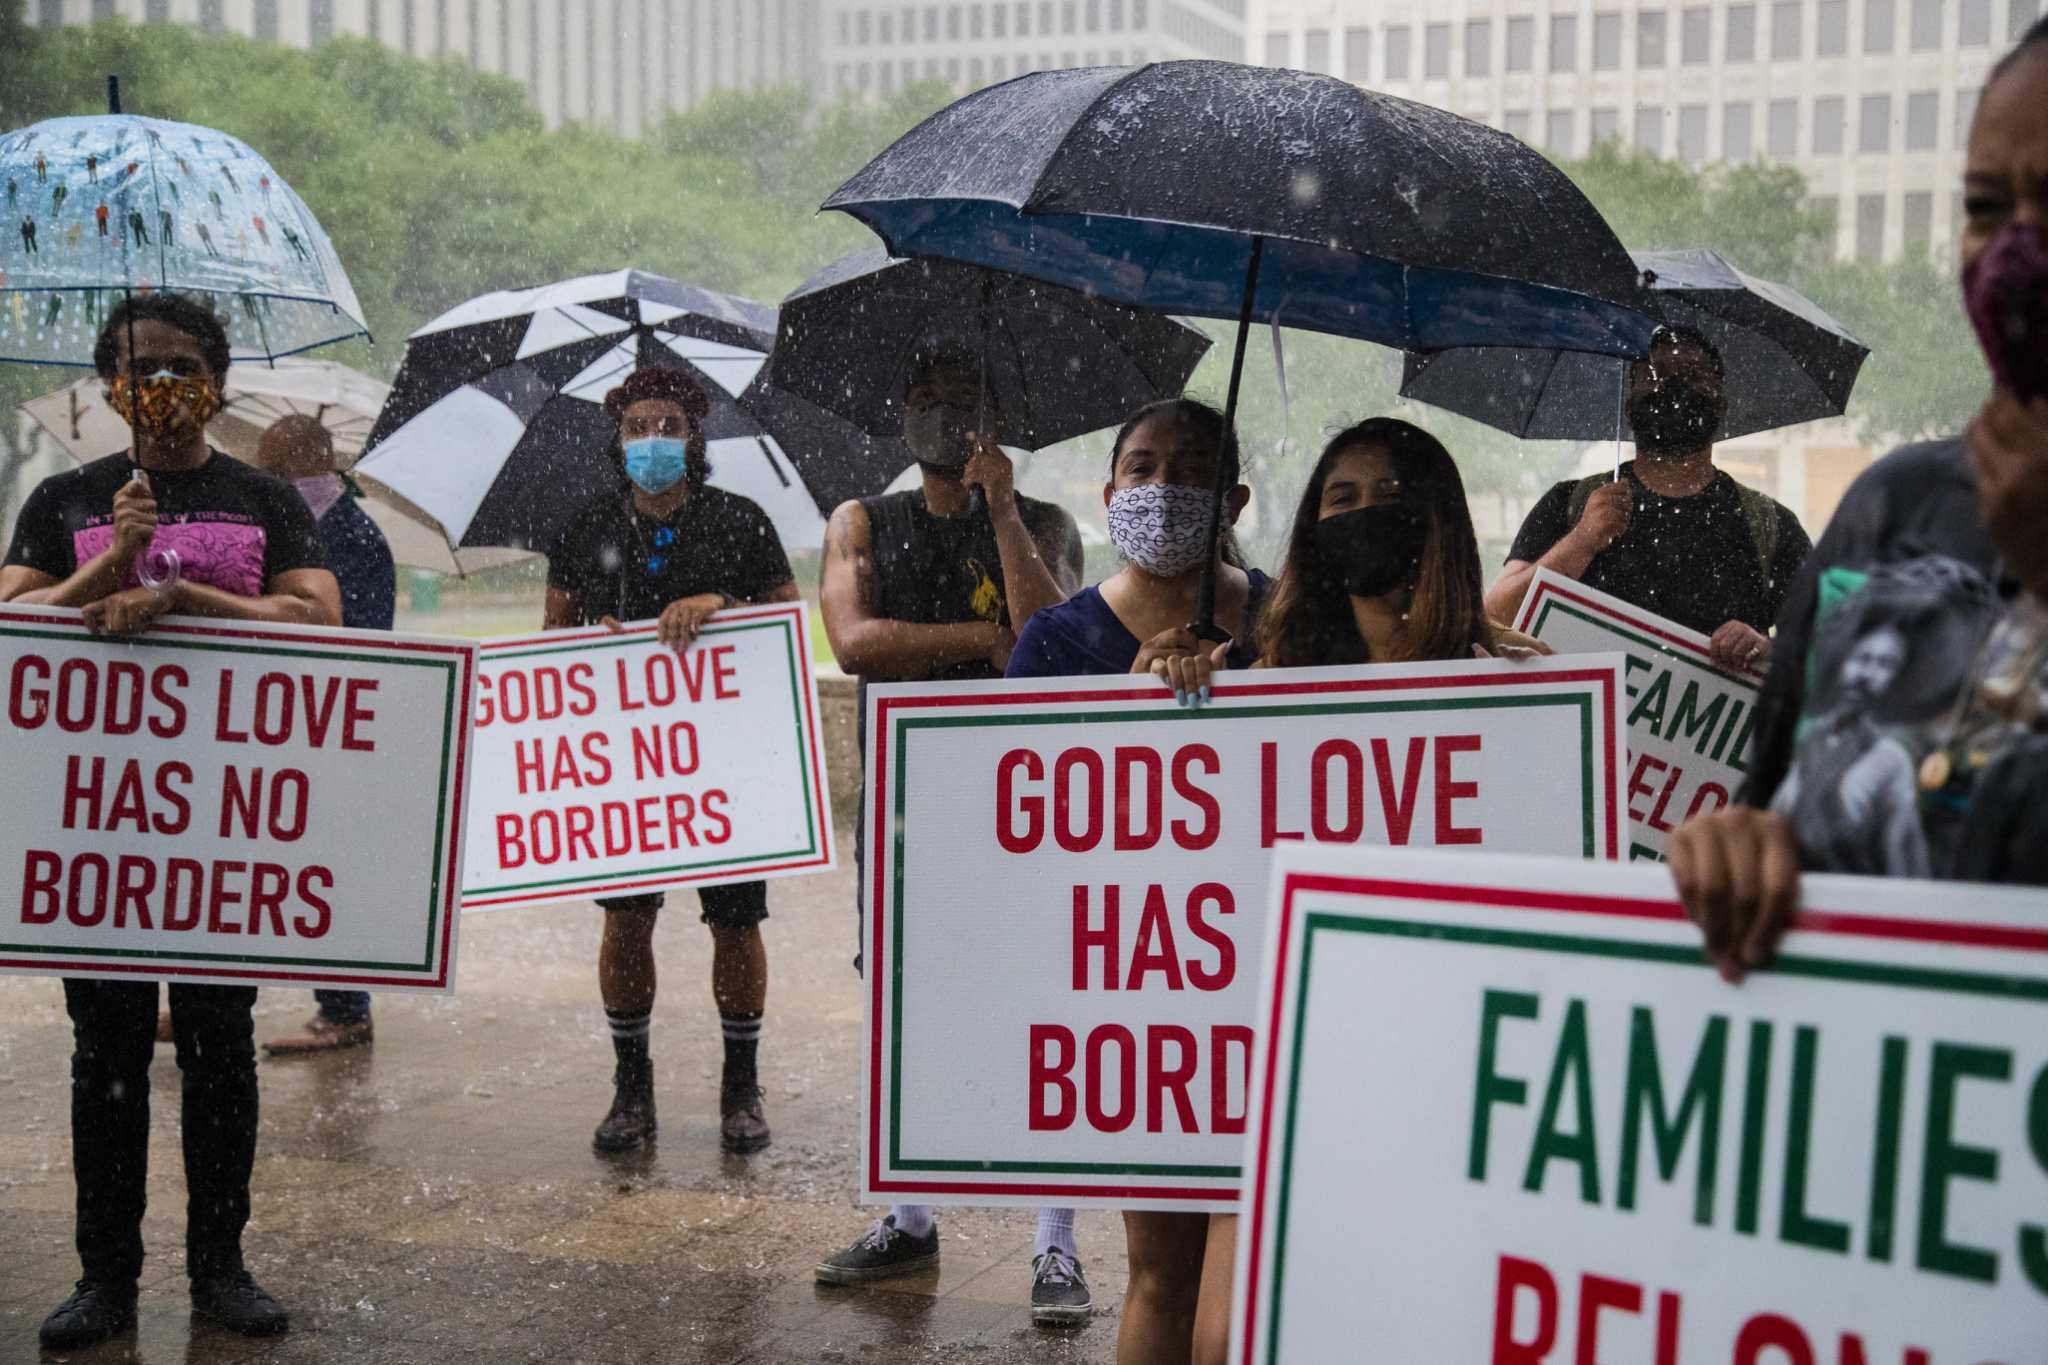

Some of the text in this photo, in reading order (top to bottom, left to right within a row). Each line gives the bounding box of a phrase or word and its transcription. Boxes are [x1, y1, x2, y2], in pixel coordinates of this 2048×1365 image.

[9, 655, 380, 752] GODS LOVE
[474, 645, 740, 727] GODS LOVE
[1625, 653, 1757, 774] FAMIL
[62, 755, 310, 843] HAS NO
[515, 721, 701, 794] HAS NO
[996, 735, 1483, 854] GODS LOVE
[496, 788, 733, 870] BORDERS
[20, 849, 335, 940] BORDERS
[1072, 882, 1237, 992] HAS
[1028, 1023, 1255, 1135] BORD
